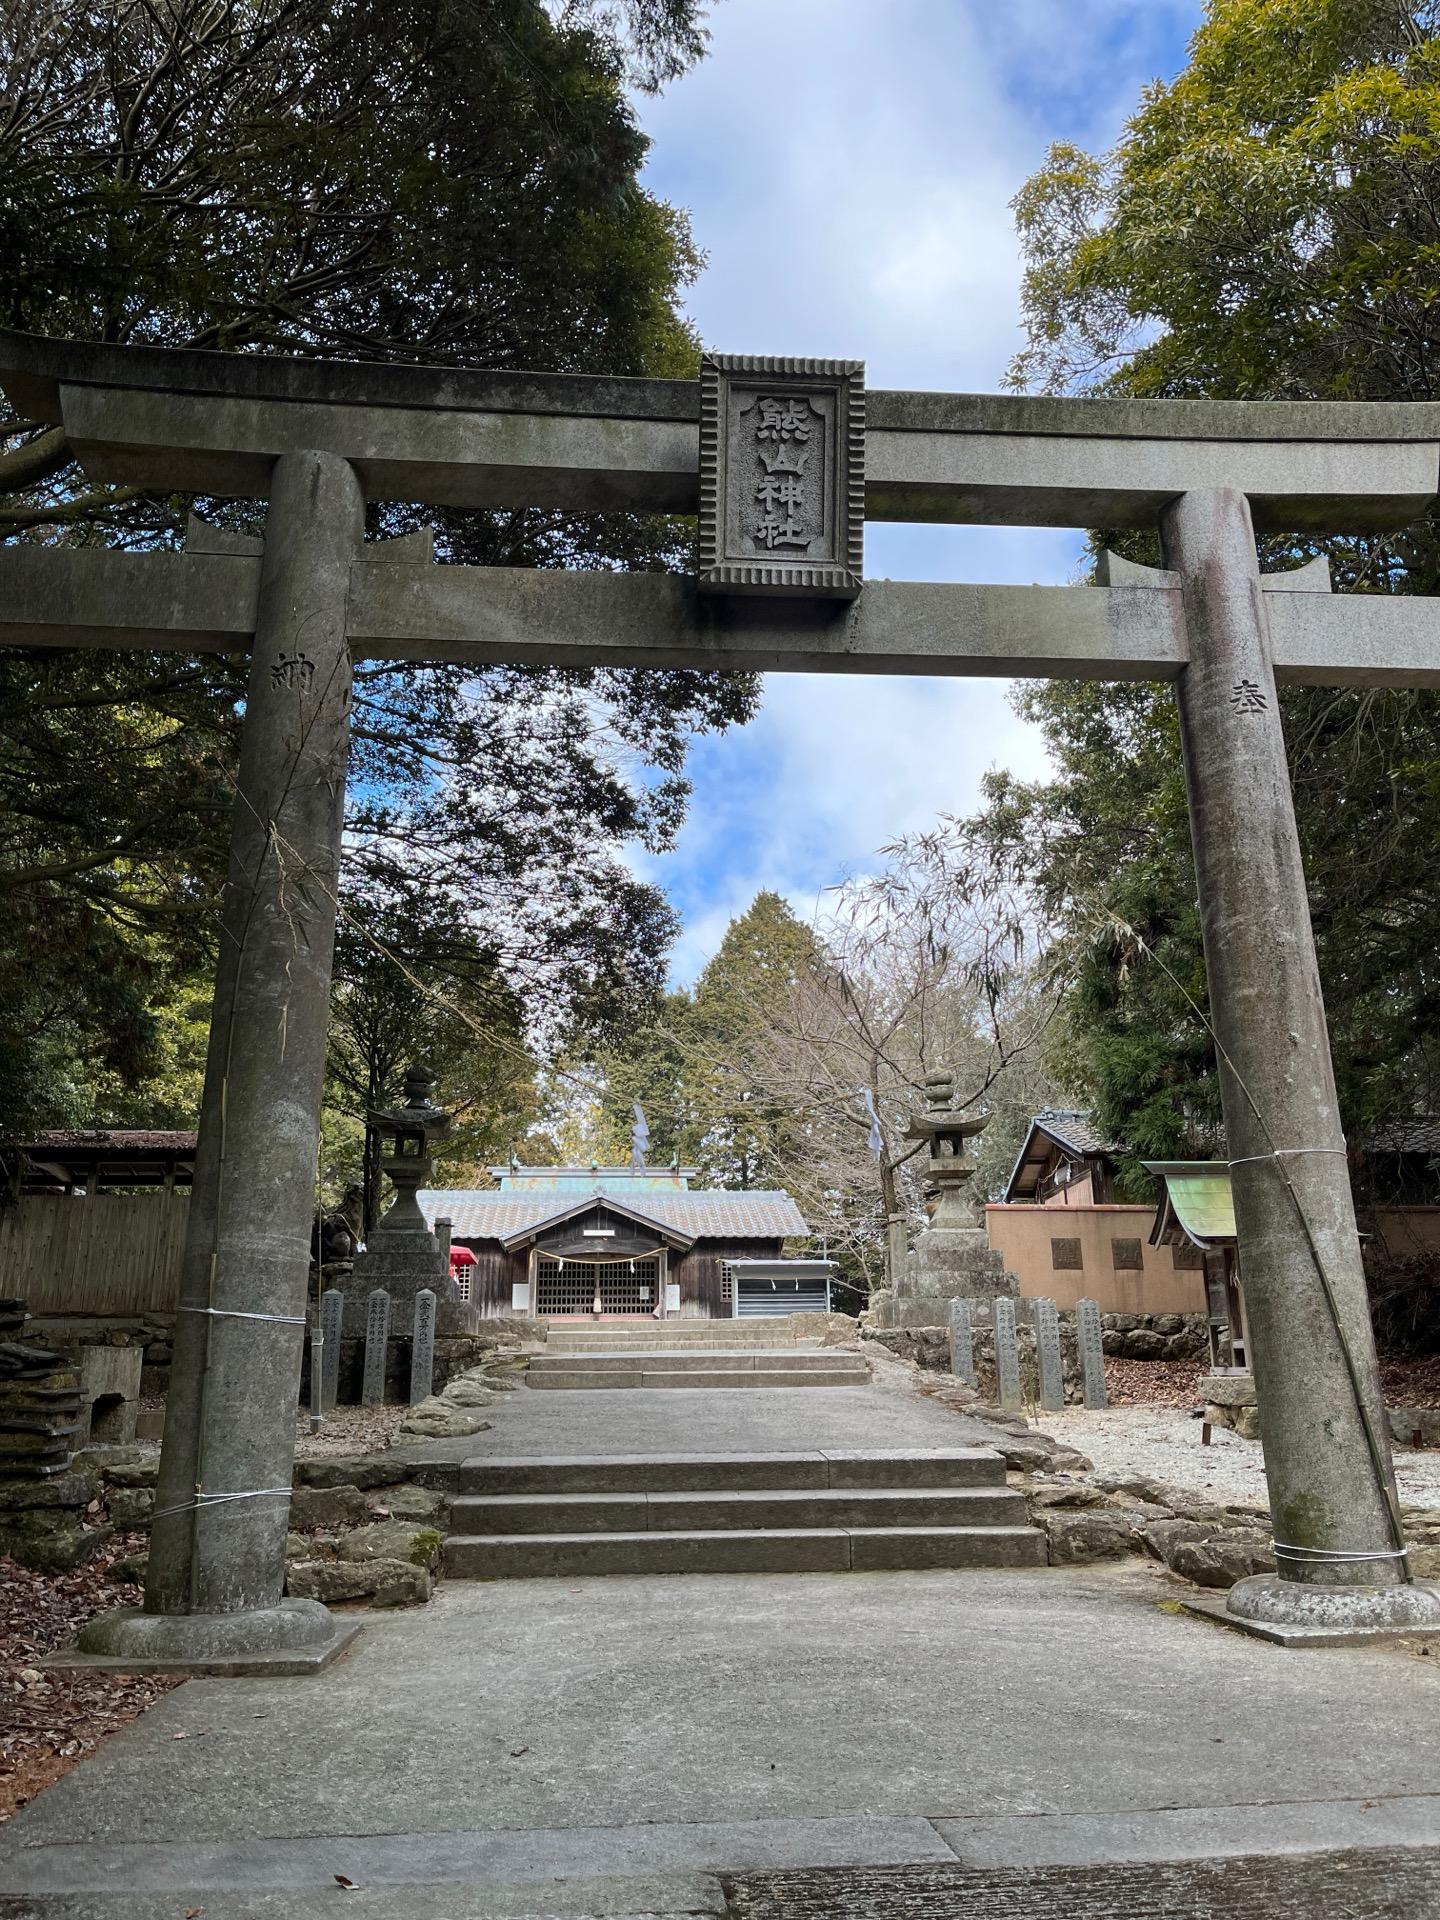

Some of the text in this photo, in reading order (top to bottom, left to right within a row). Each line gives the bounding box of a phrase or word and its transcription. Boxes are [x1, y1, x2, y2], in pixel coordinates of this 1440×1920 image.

[757, 397, 811, 549] 熊山神社
[1230, 679, 1268, 718] 奉
